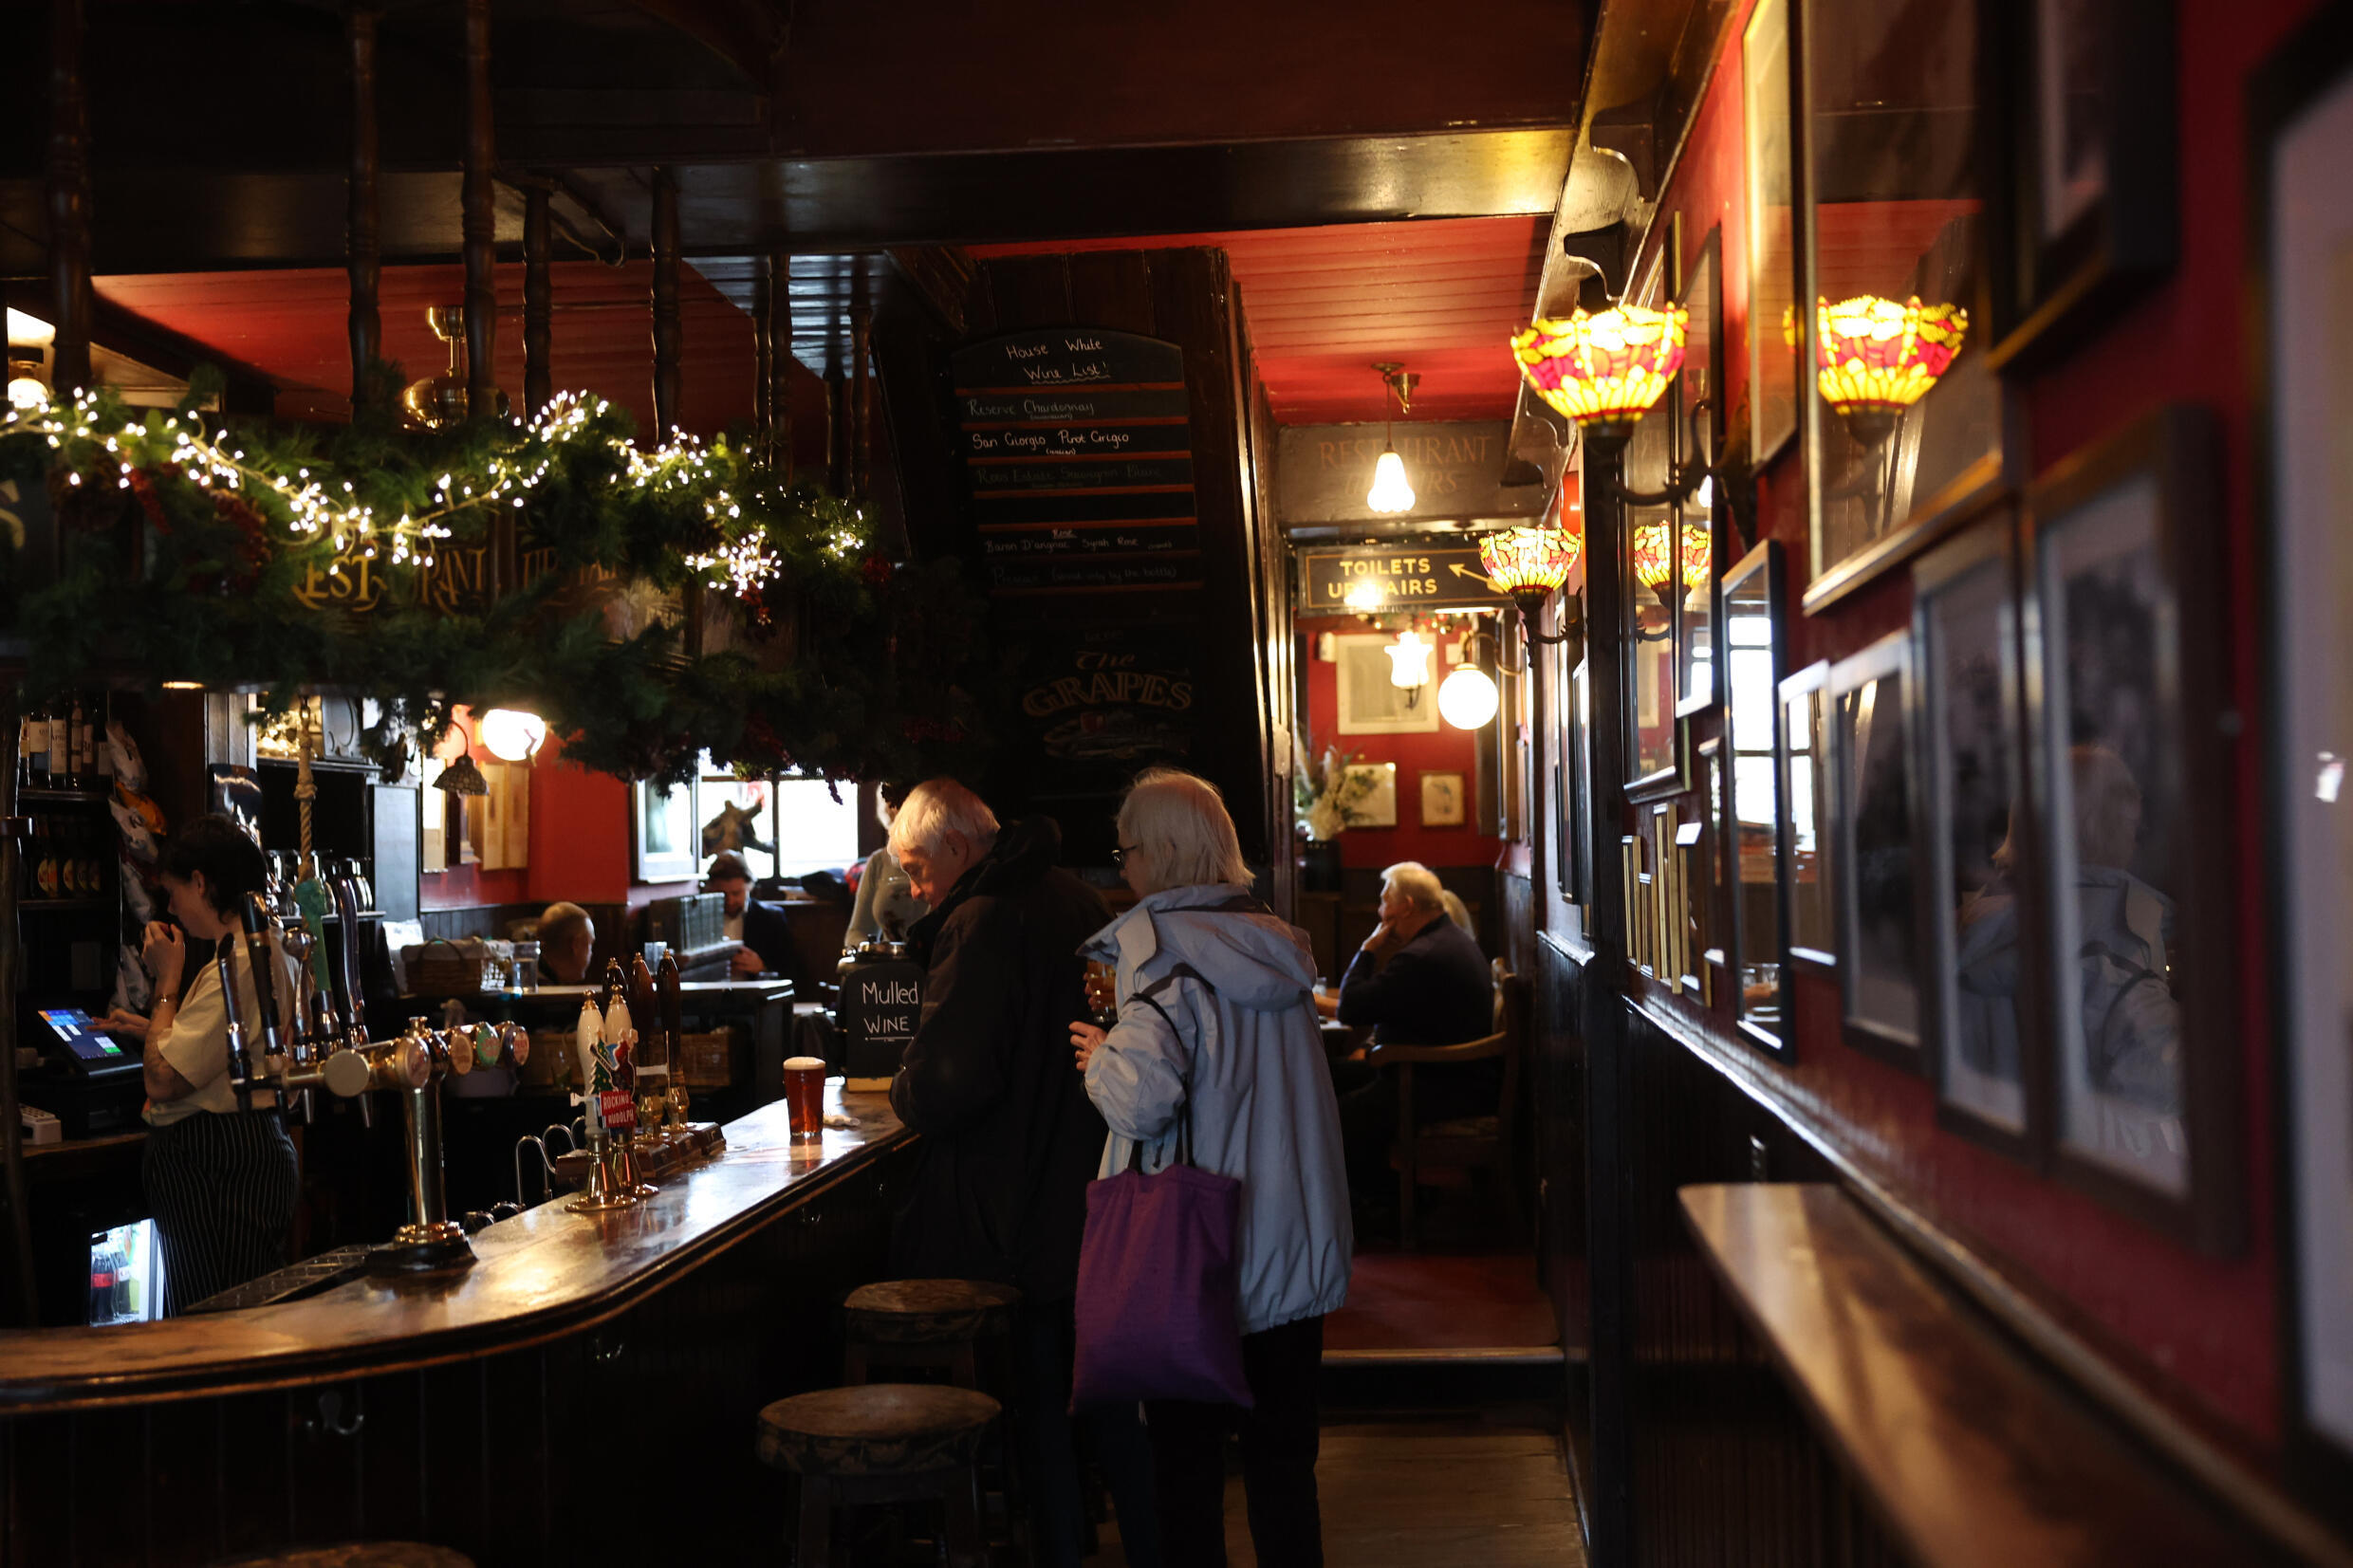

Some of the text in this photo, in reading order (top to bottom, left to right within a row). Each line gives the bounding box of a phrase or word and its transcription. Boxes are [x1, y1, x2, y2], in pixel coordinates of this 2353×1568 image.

[1006, 338, 1105, 360] House White
[1024, 364, 1062, 380] Wine
[968, 398, 1095, 416] Reserve Chardonnay
[972, 433, 998, 450] San
[1339, 558, 1431, 576] TOILETS
[1327, 578, 1438, 600] UPAIRS
[1075, 649, 1138, 671] The
[1022, 671, 1193, 718] GRAPES
[862, 980, 919, 1005] Mulled
[863, 1014, 911, 1034] WINE
